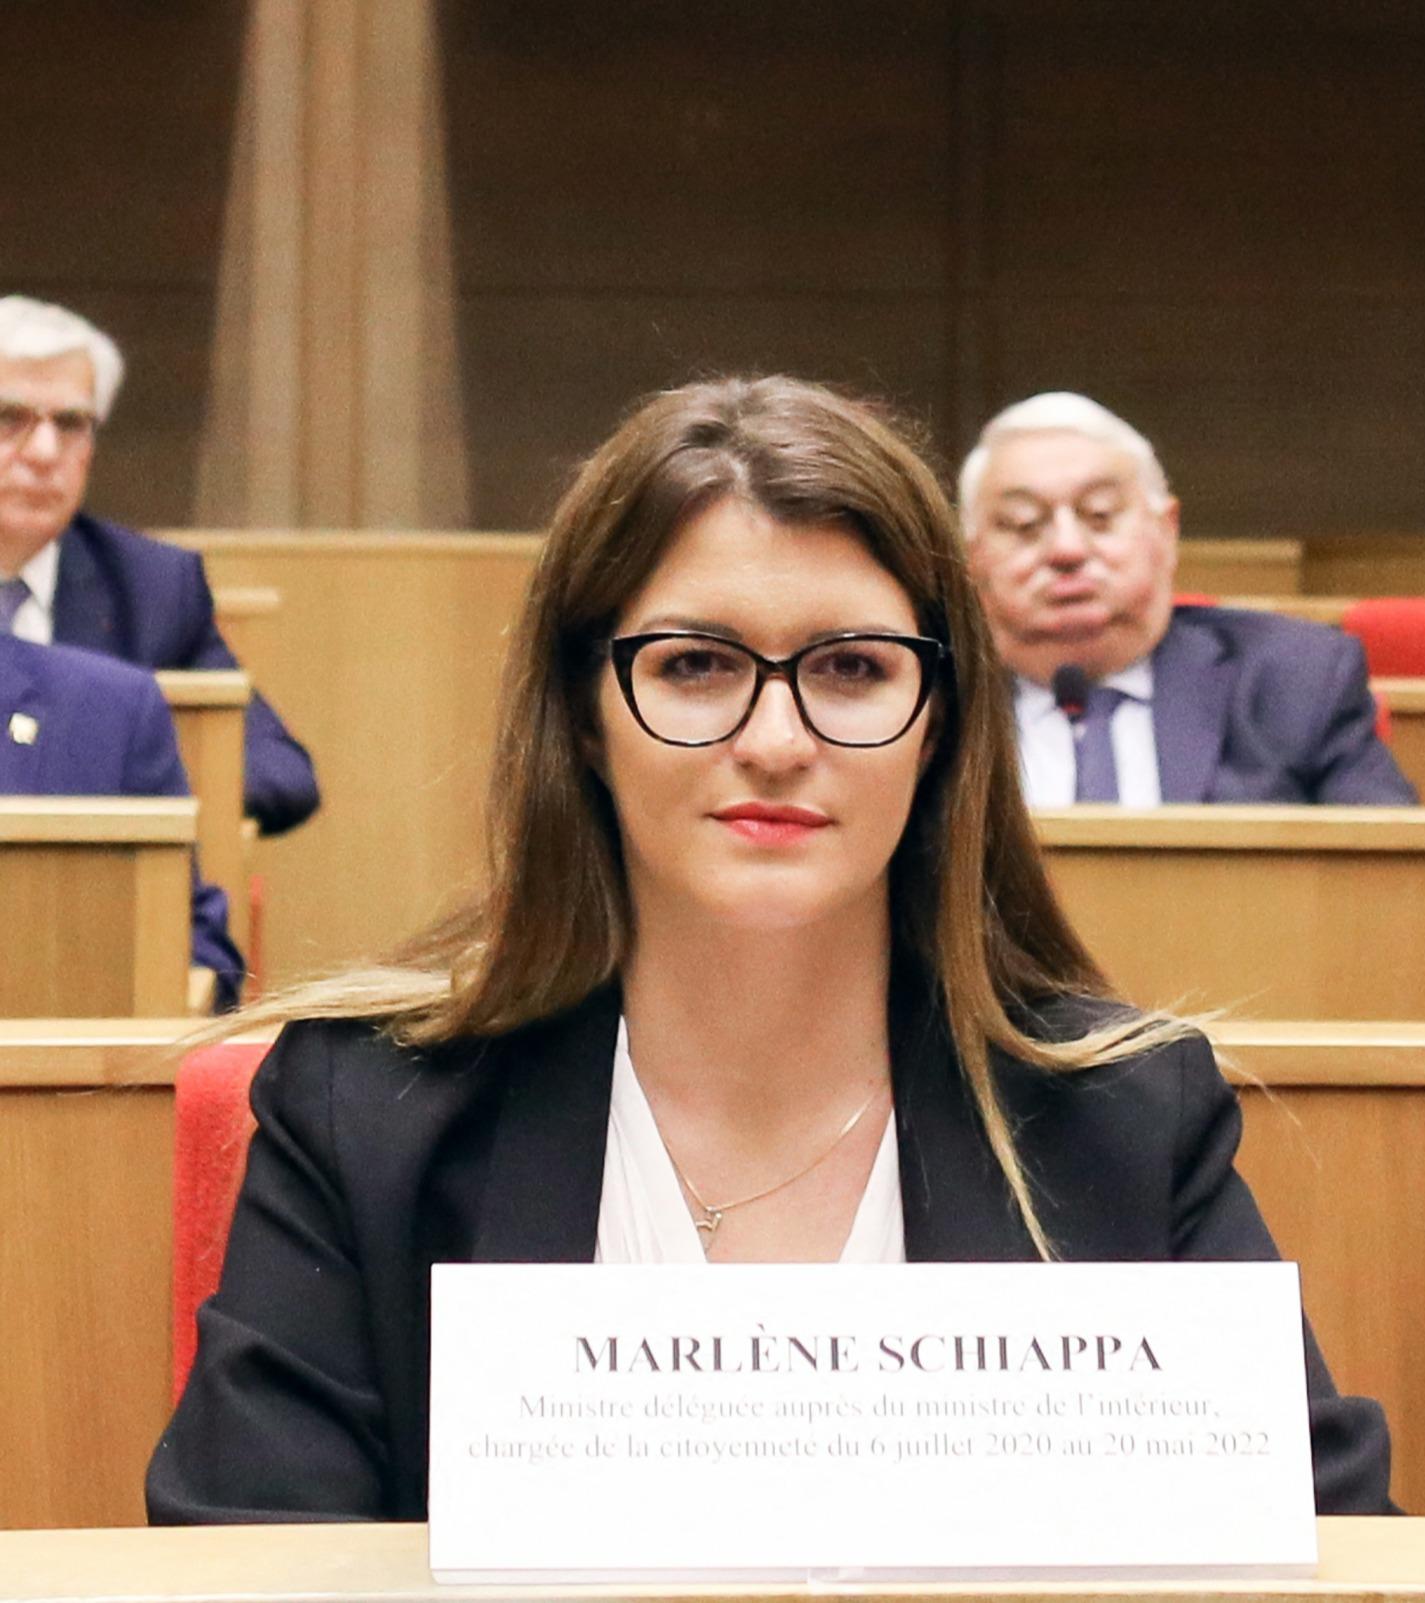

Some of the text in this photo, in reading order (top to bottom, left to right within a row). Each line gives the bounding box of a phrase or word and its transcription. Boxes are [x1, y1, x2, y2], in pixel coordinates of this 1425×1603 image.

[573, 1322, 1164, 1374] MARLÈNE SCHIAPPA
[518, 1393, 633, 1418] Ministre
[642, 1392, 764, 1425] déléguée
[774, 1394, 863, 1424] auprès
[871, 1392, 905, 1417] du
[914, 1393, 1026, 1417] ministre
[1034, 1391, 1068, 1417] de
[467, 1430, 1272, 1465] chargée de la citoyenneté du 6 juillet 2020 au 20 mai 2022
